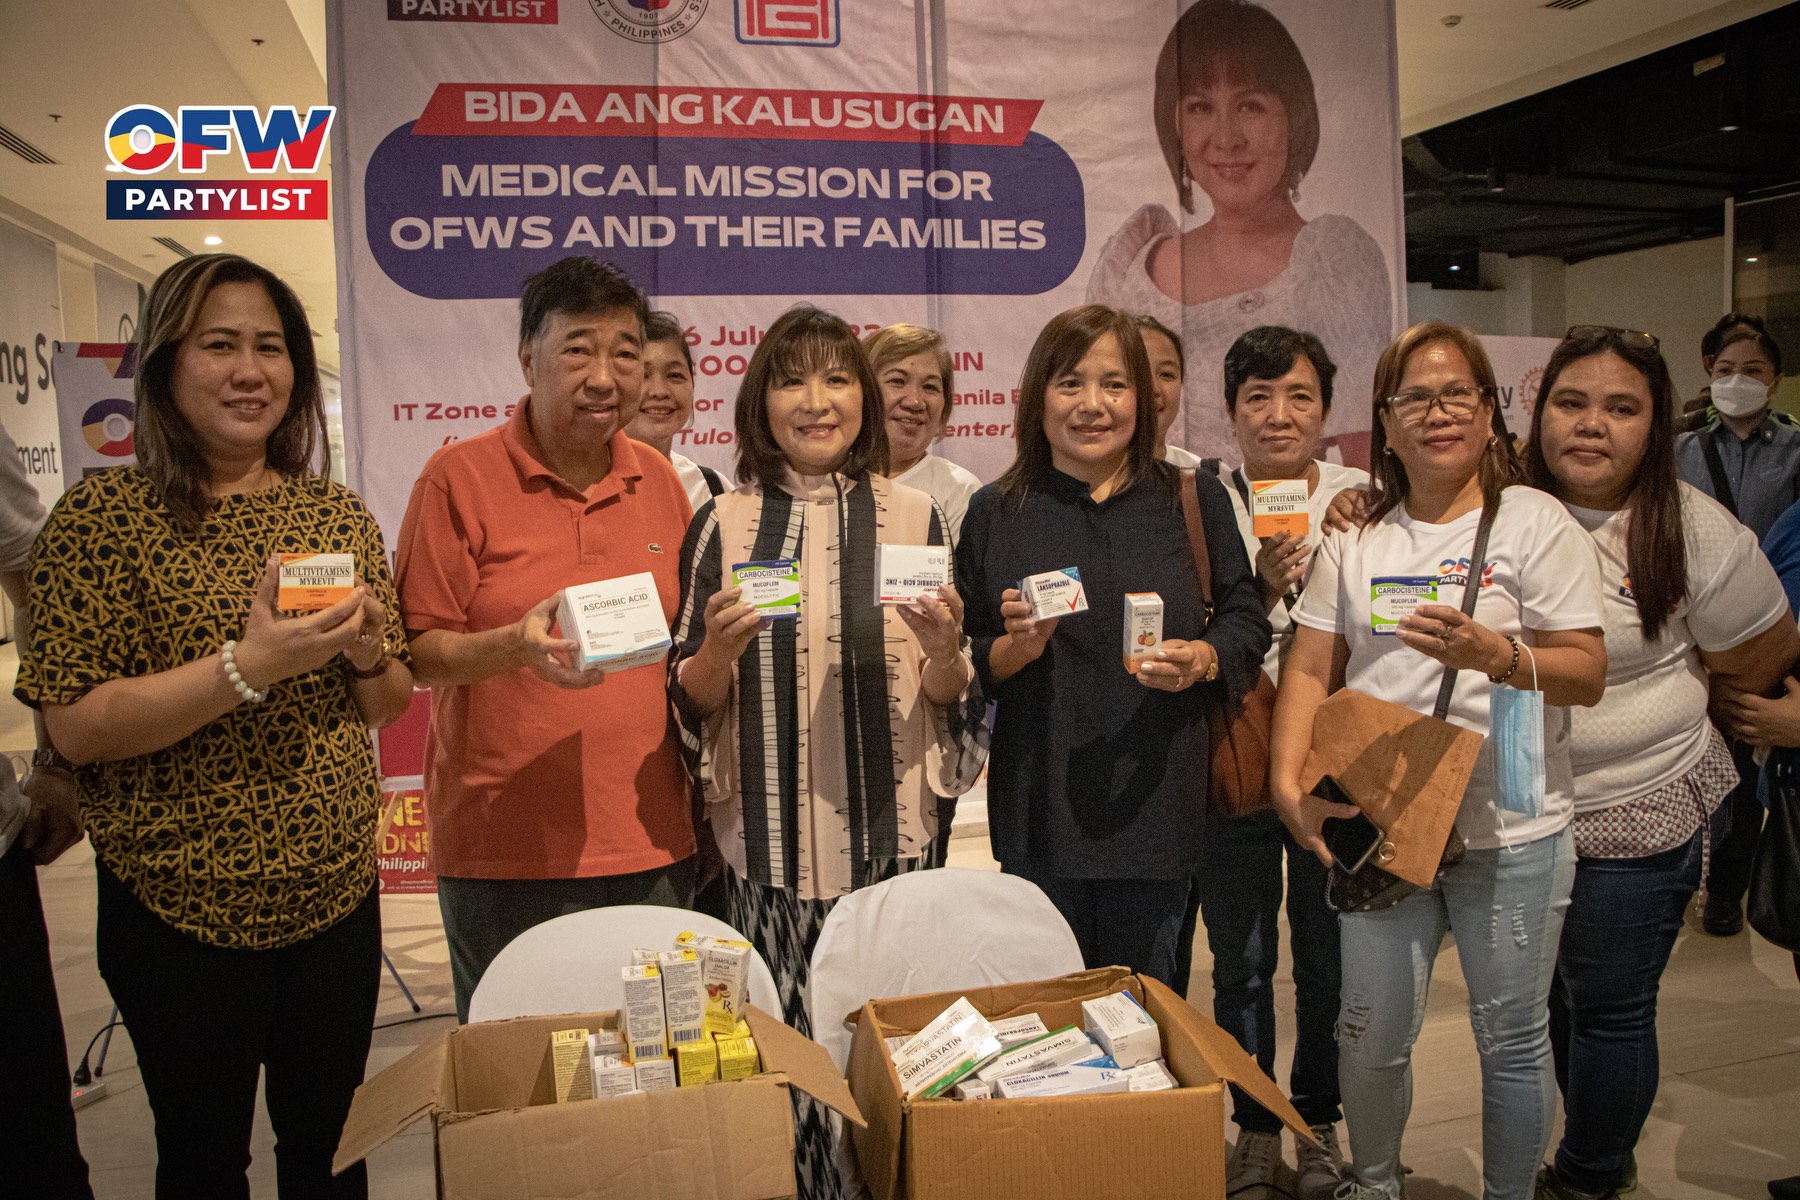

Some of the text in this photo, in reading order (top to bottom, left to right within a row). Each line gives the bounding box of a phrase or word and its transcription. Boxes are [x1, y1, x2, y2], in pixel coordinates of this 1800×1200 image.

[611, 17, 686, 38] PHILIPPINES
[464, 90, 1005, 134] BIDA ANG KALUSUGAN
[441, 164, 994, 202] MEDICAL MISSION FOR
[389, 215, 1047, 250] OFWS AND THEIR FAMILIES
[952, 389, 1006, 405] anila
[393, 403, 419, 421] IT
[425, 402, 498, 420] Zone
[679, 427, 737, 446] Tulo
[945, 421, 1017, 438] enter)
[1257, 494, 1306, 504] MULTIVITAMINS
[1267, 504, 1295, 512] MYREVIT
[284, 567, 350, 577] MULTIVITAMINS
[739, 568, 791, 579] CARBOCISTEINE
[299, 577, 336, 586] MYREVIT
[1377, 586, 1431, 595] CARBOCISTEINE
[583, 596, 627, 612] ASCORBIC
[628, 592, 649, 603] ACID
[377, 857, 427, 873] Philippi
[903, 1036, 963, 1081] SIMVASTATIN
[1005, 1037, 1072, 1067] SIMVASTATIN
